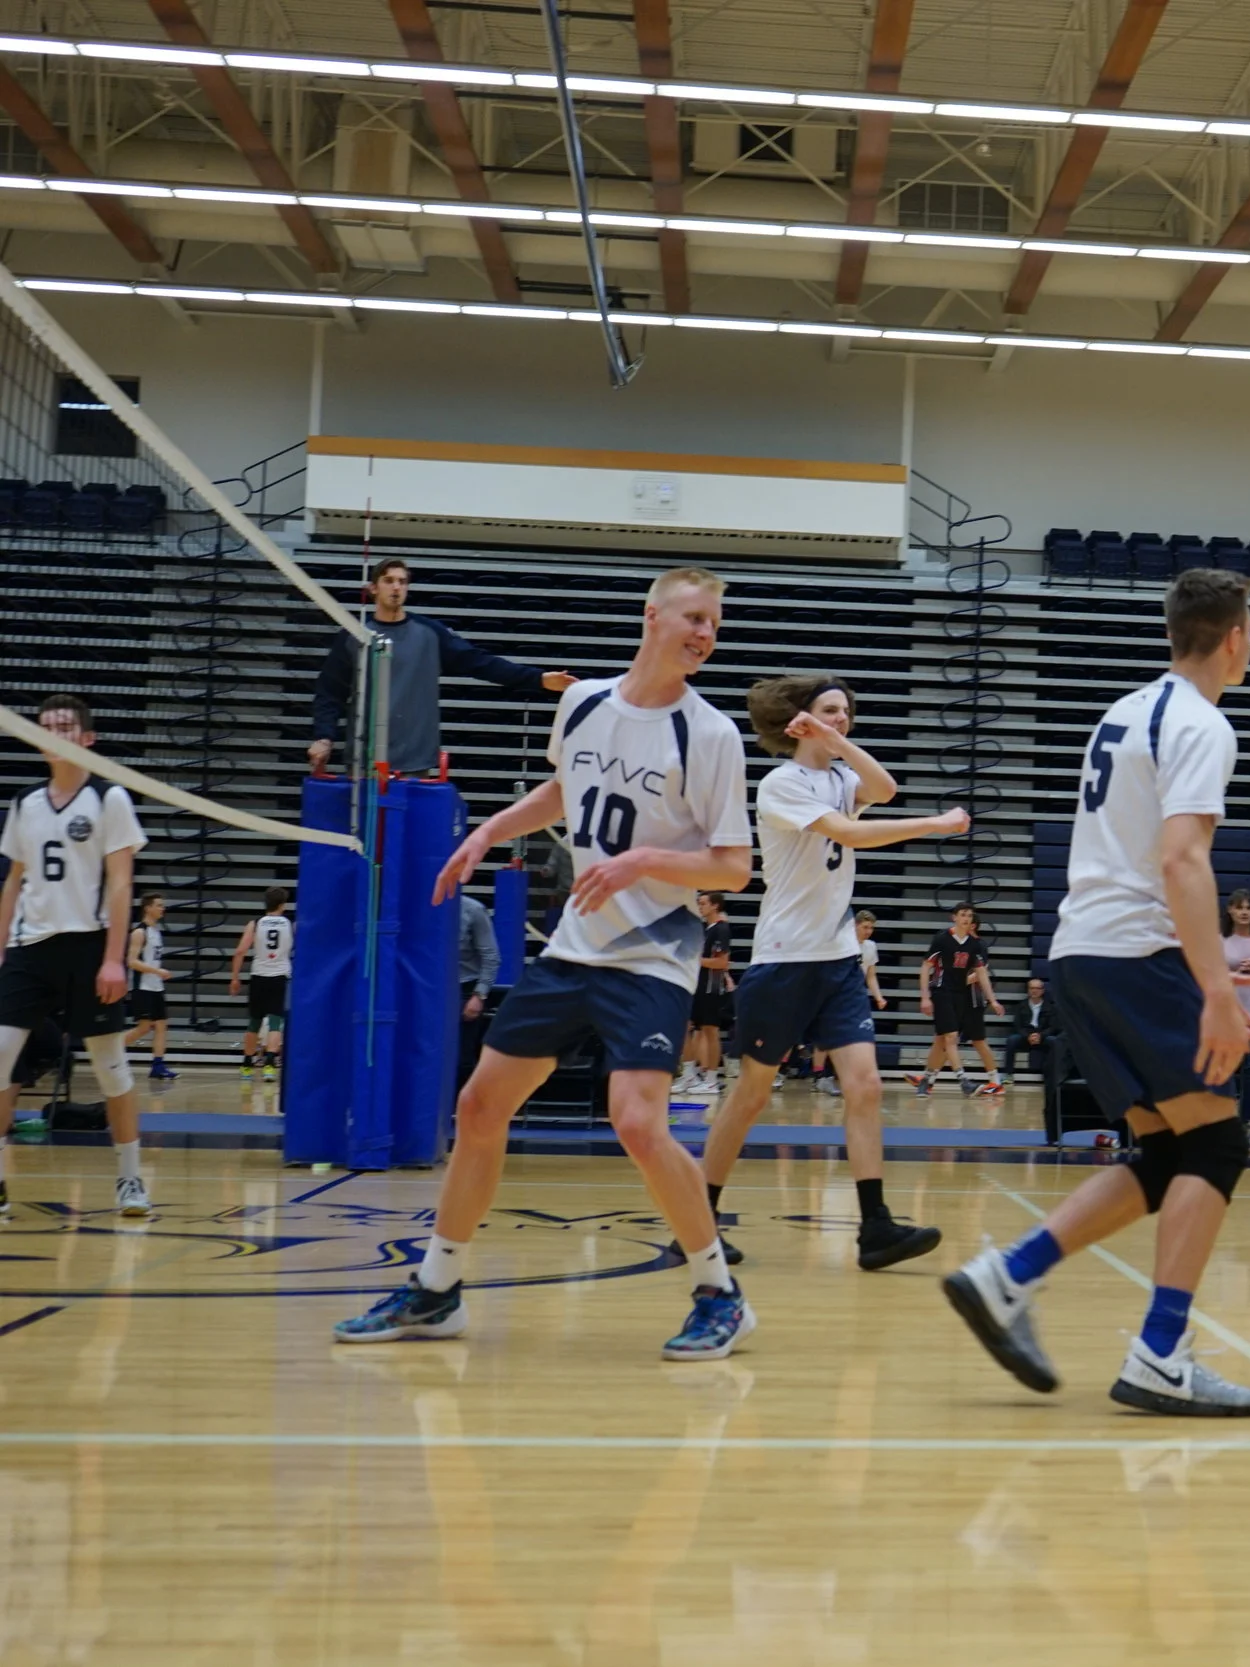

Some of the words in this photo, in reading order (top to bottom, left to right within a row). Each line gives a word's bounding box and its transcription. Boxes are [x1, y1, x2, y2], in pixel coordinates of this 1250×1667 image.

[572, 751, 667, 797] FVVC
[1084, 722, 1130, 813] 5
[573, 786, 638, 857] 10
[42, 840, 65, 882] 6
[266, 929, 280, 950] 9
